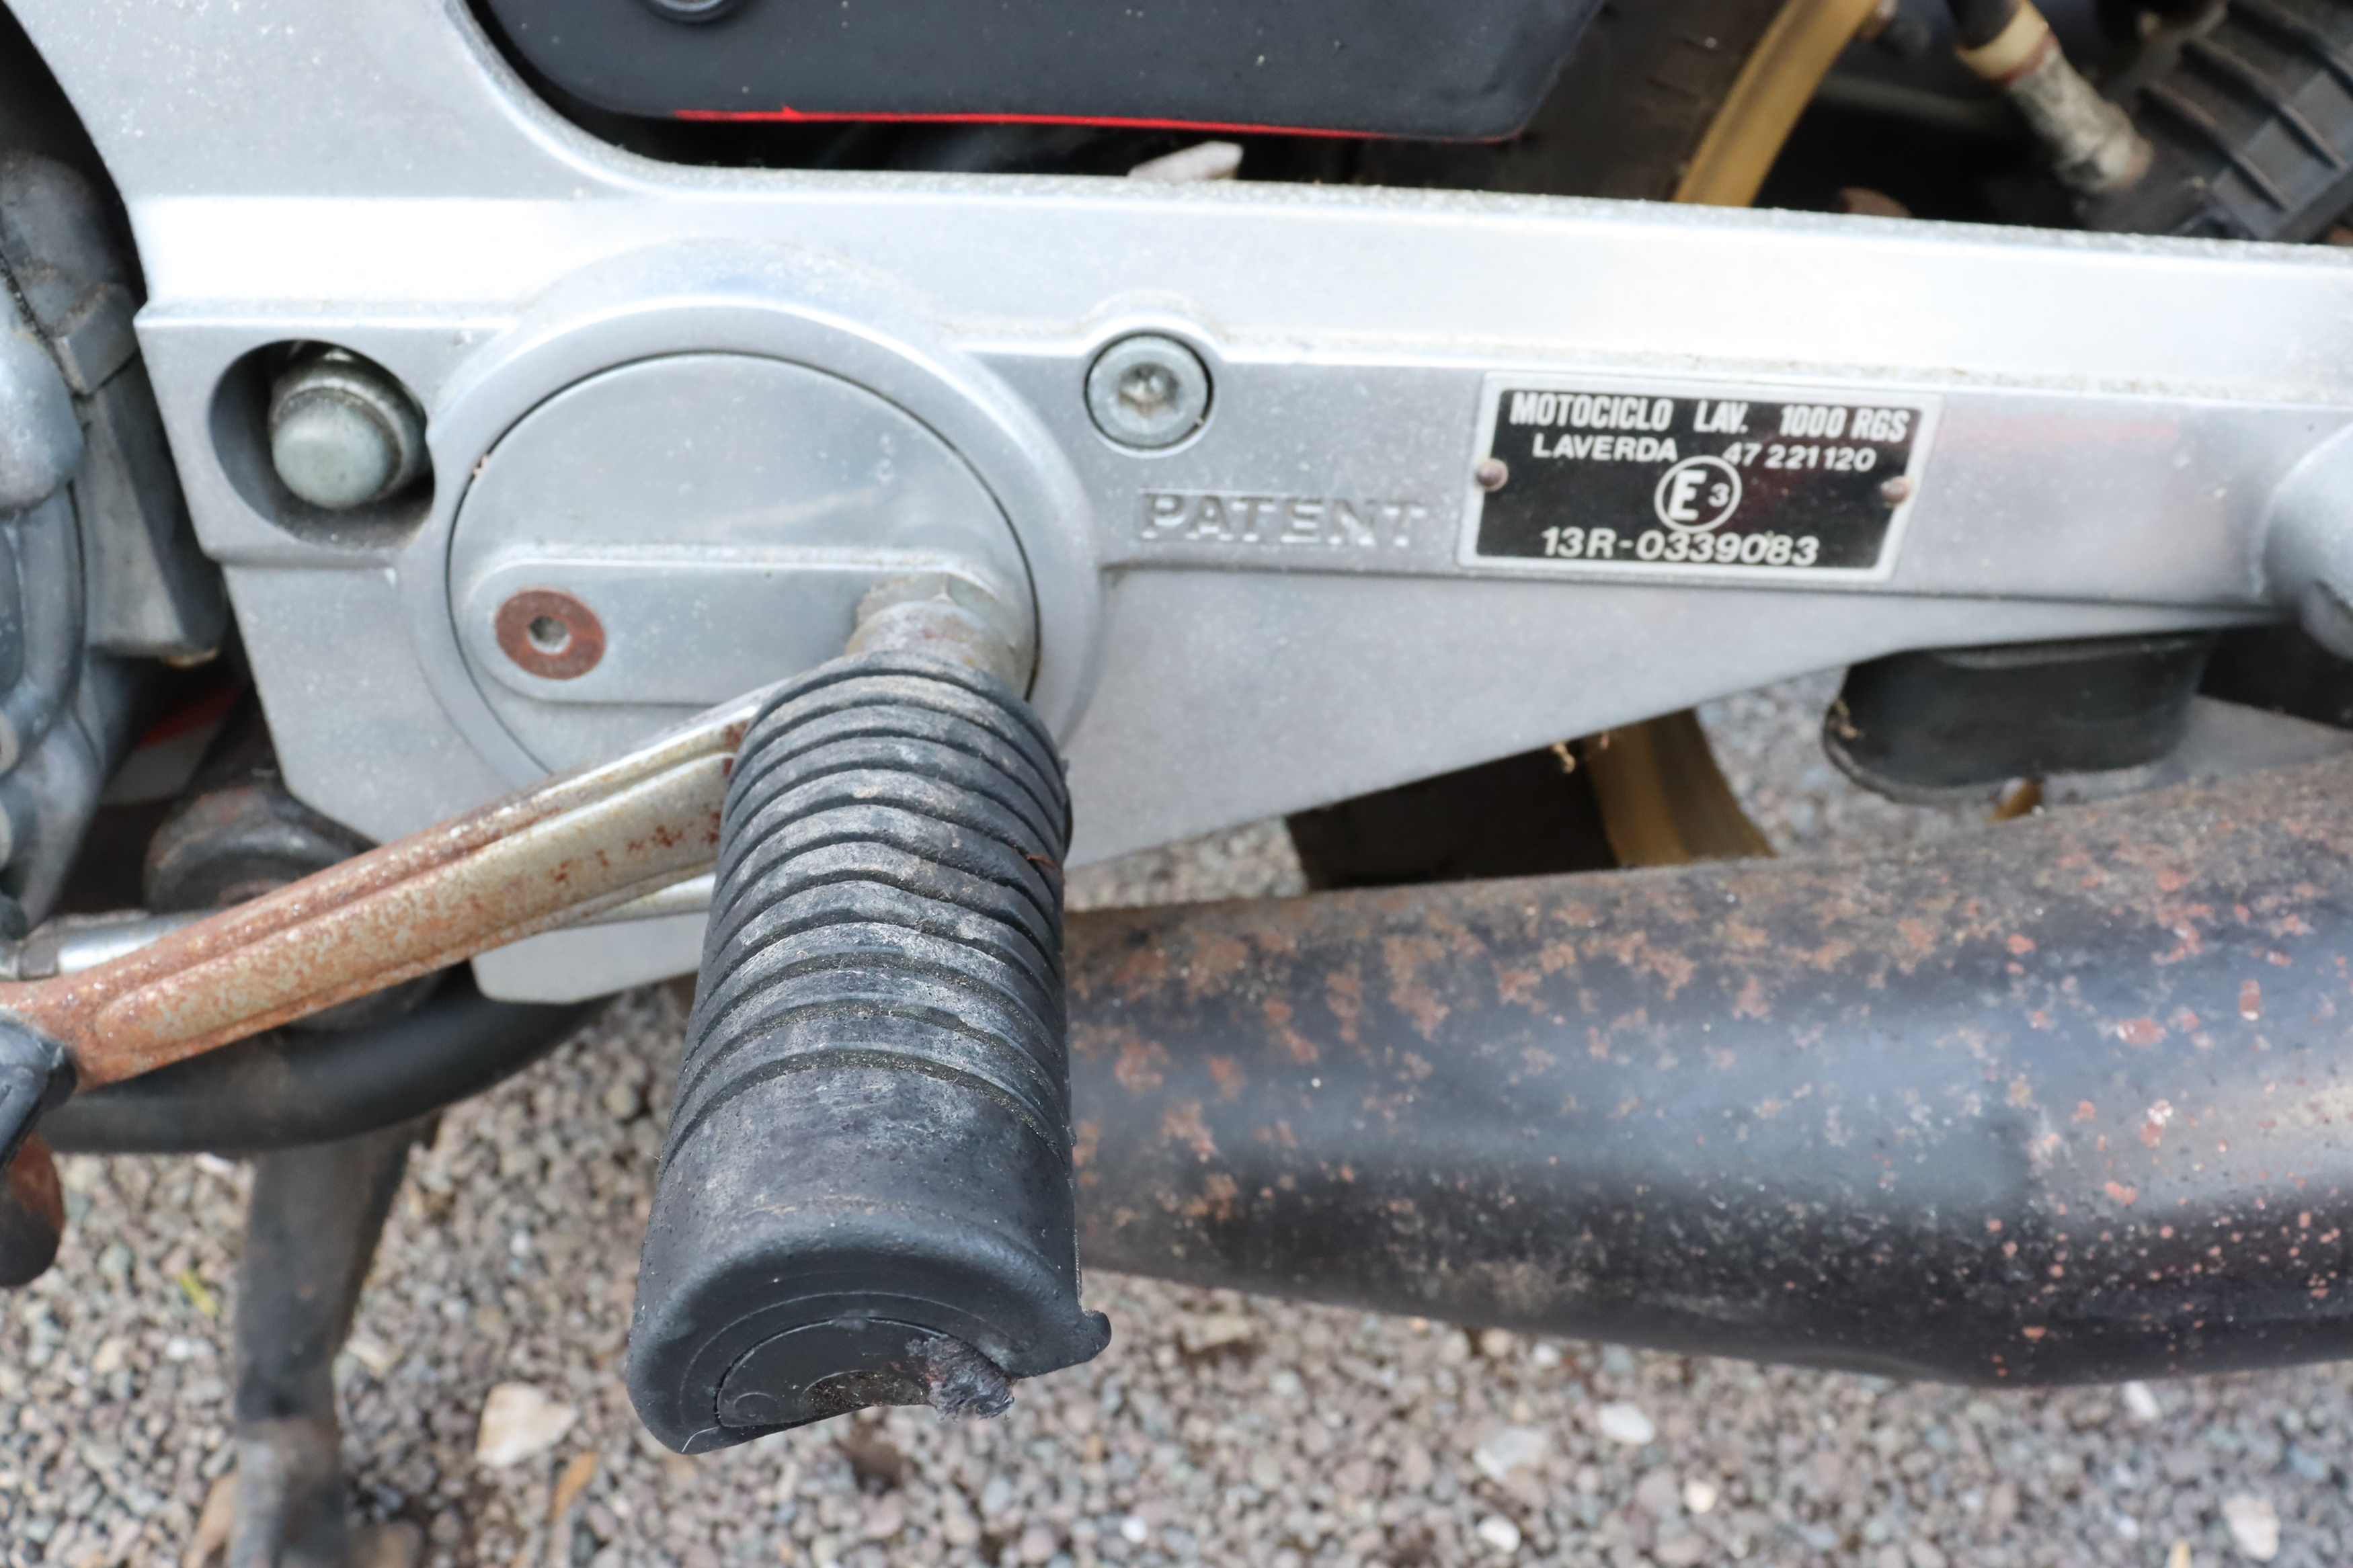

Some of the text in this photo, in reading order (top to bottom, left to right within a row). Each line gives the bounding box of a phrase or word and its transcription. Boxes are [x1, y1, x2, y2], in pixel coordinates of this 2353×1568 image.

[1509, 392, 1910, 442] MOTOCICLO LAV. 1000 RGS
[1532, 434, 1679, 462] LAVERDA
[1141, 493, 1428, 547] PATENT
[1668, 470, 1706, 521] E
[1541, 526, 1820, 567] 13R-0339083
